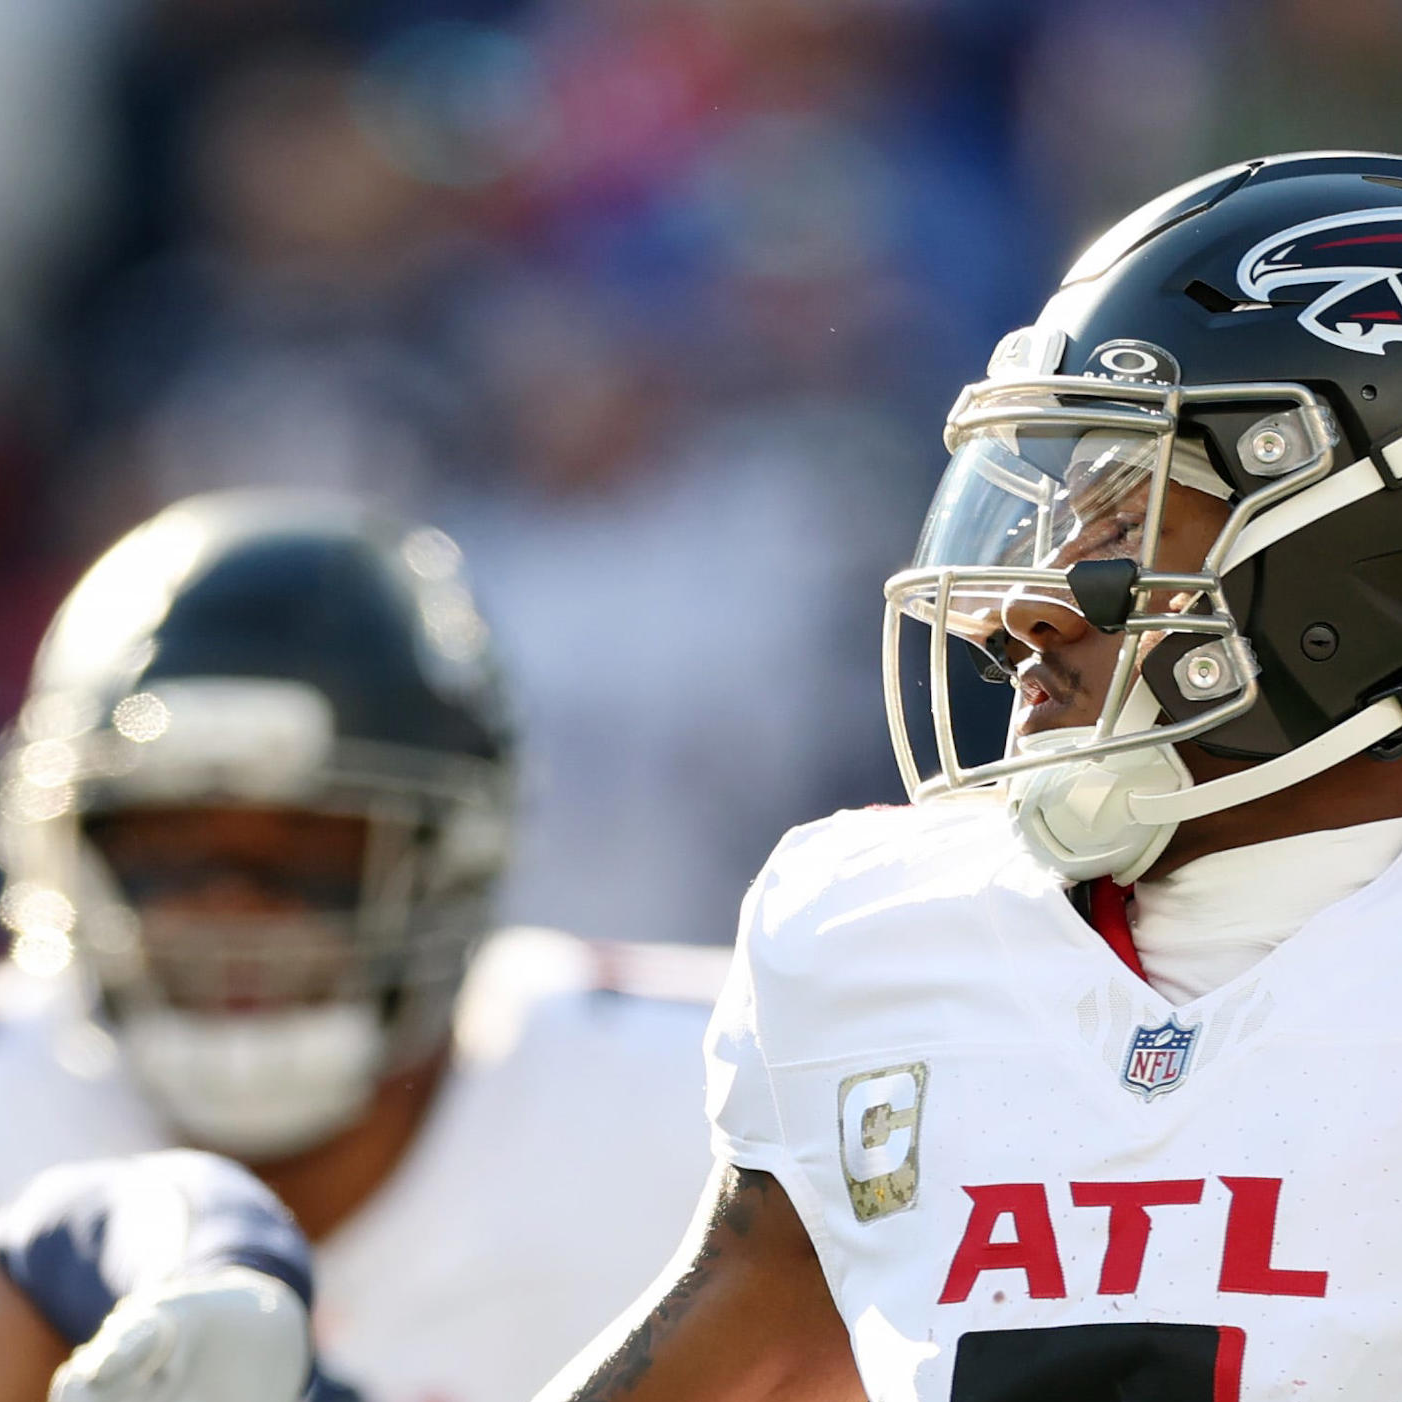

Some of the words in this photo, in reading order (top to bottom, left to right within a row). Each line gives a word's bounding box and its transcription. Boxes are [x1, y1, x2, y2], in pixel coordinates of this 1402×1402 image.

[1129, 1050, 1178, 1083] NFL
[843, 1072, 917, 1182] C
[938, 1175, 1329, 1304] ATL
